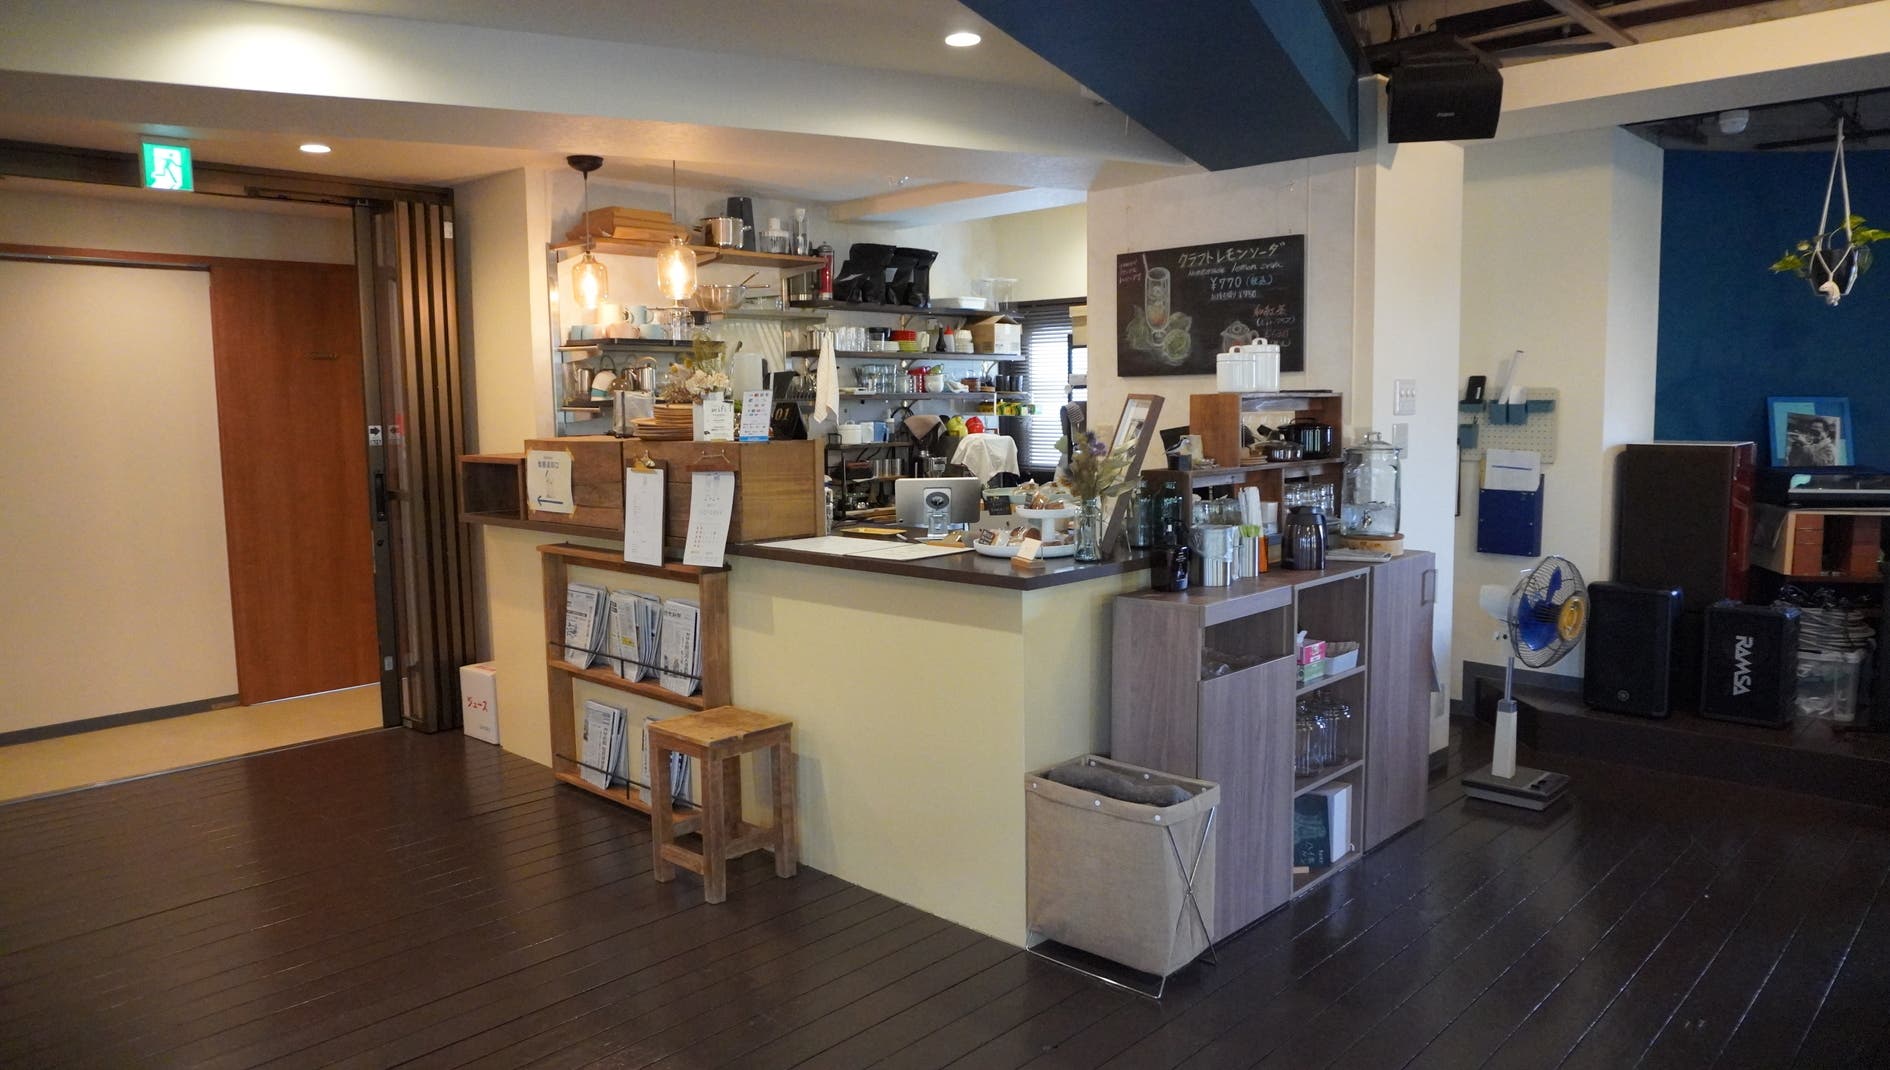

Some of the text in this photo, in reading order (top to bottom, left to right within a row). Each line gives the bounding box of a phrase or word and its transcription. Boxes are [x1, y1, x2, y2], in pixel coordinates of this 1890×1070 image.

[1178, 241, 1286, 268] クラフトレモンソーダ
[1210, 276, 1242, 291] ¥770
[774, 407, 790, 421] 01
[1733, 635, 1754, 696] RAMSA
[467, 696, 488, 713] ジュース
